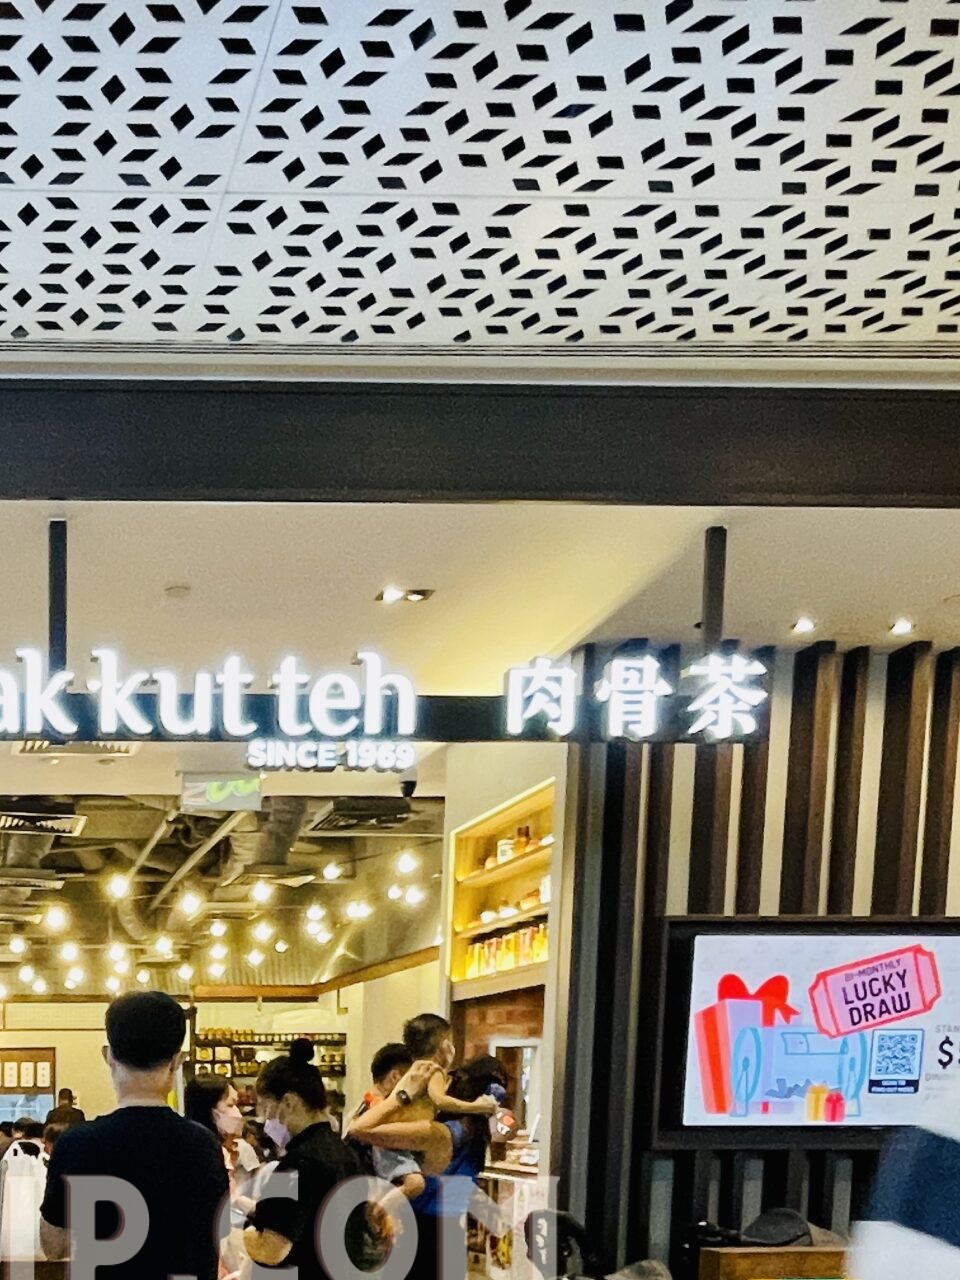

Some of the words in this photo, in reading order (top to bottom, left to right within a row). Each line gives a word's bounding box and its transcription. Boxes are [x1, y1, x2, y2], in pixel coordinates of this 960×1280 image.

[90, 647, 258, 736] kut
[272, 649, 418, 737] teh
[504, 652, 769, 739] 肉骨茶
[247, 738, 338, 768] SINCE
[344, 739, 417, 769] 1969
[841, 968, 907, 1005] LUCKY
[848, 991, 911, 1026] DRAW
